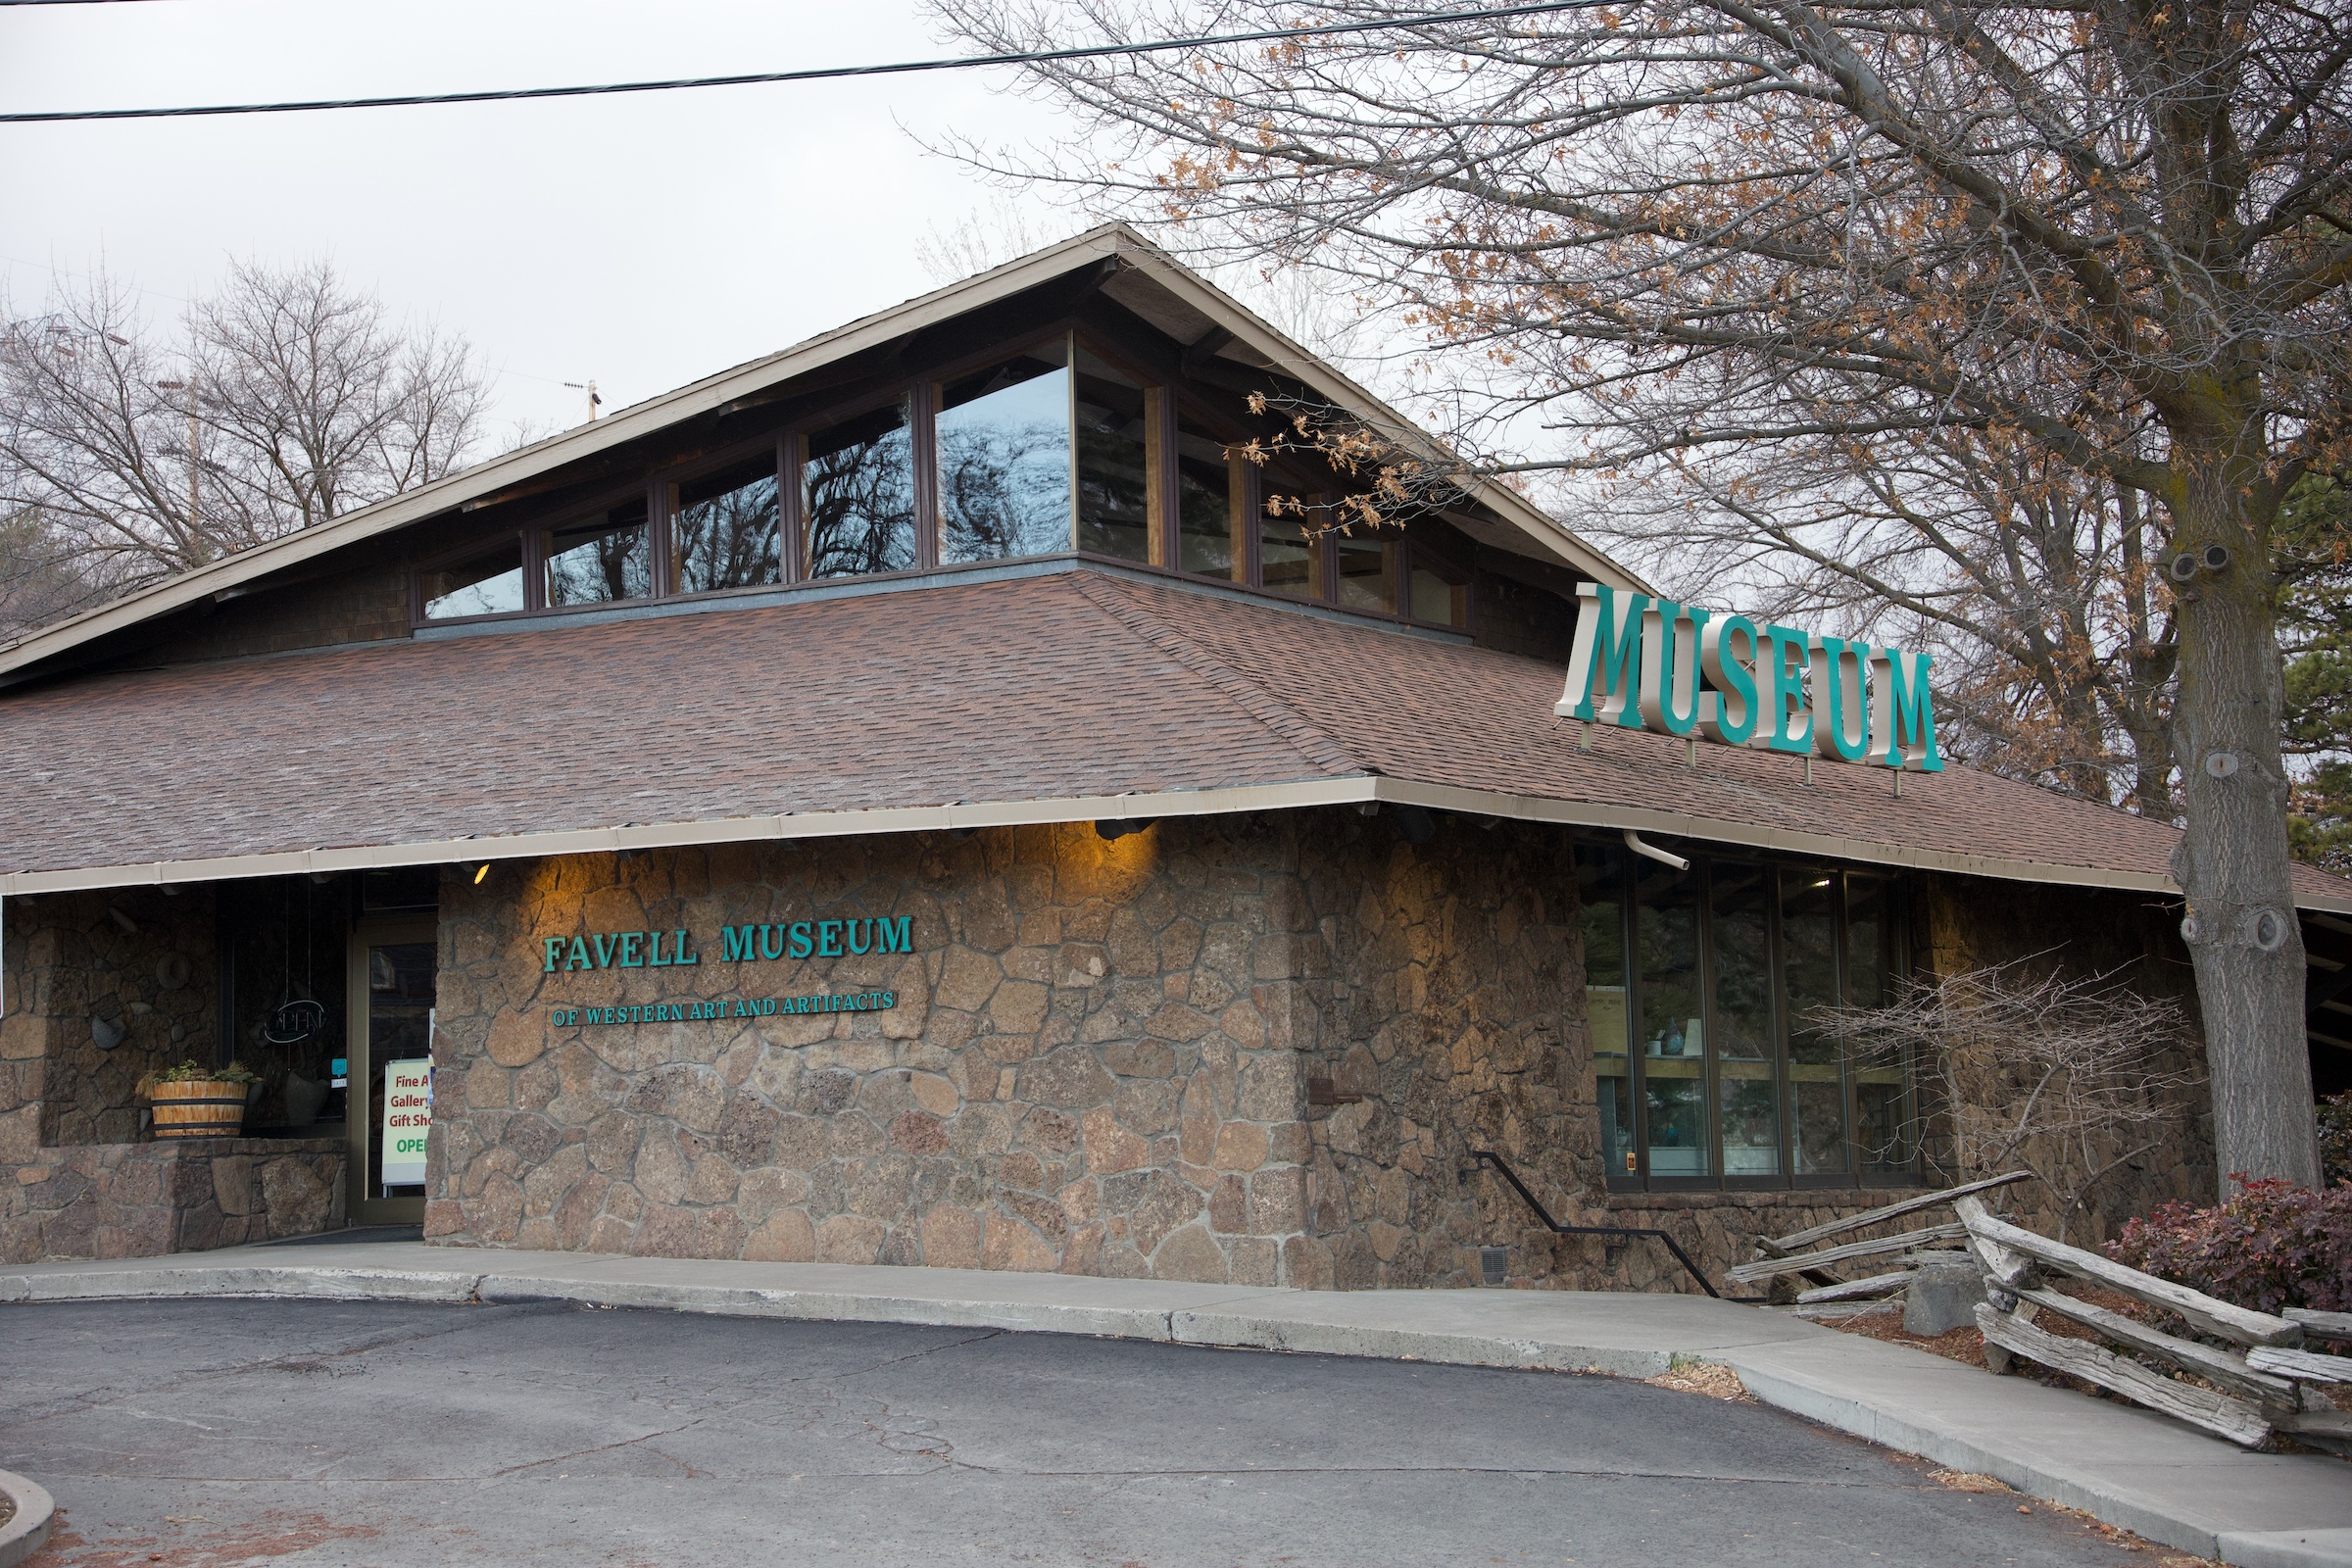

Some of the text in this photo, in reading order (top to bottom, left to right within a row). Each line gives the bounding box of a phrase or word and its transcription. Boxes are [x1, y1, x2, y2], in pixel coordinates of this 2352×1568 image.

[1554, 581, 1944, 772] MUSEUM
[544, 915, 913, 972] FAVELL MUSEUM
[553, 992, 895, 1027] OF WESTERN ART AND ARTIFACTS
[396, 1075, 419, 1088] Fine
[389, 1114, 411, 1127] Gift
